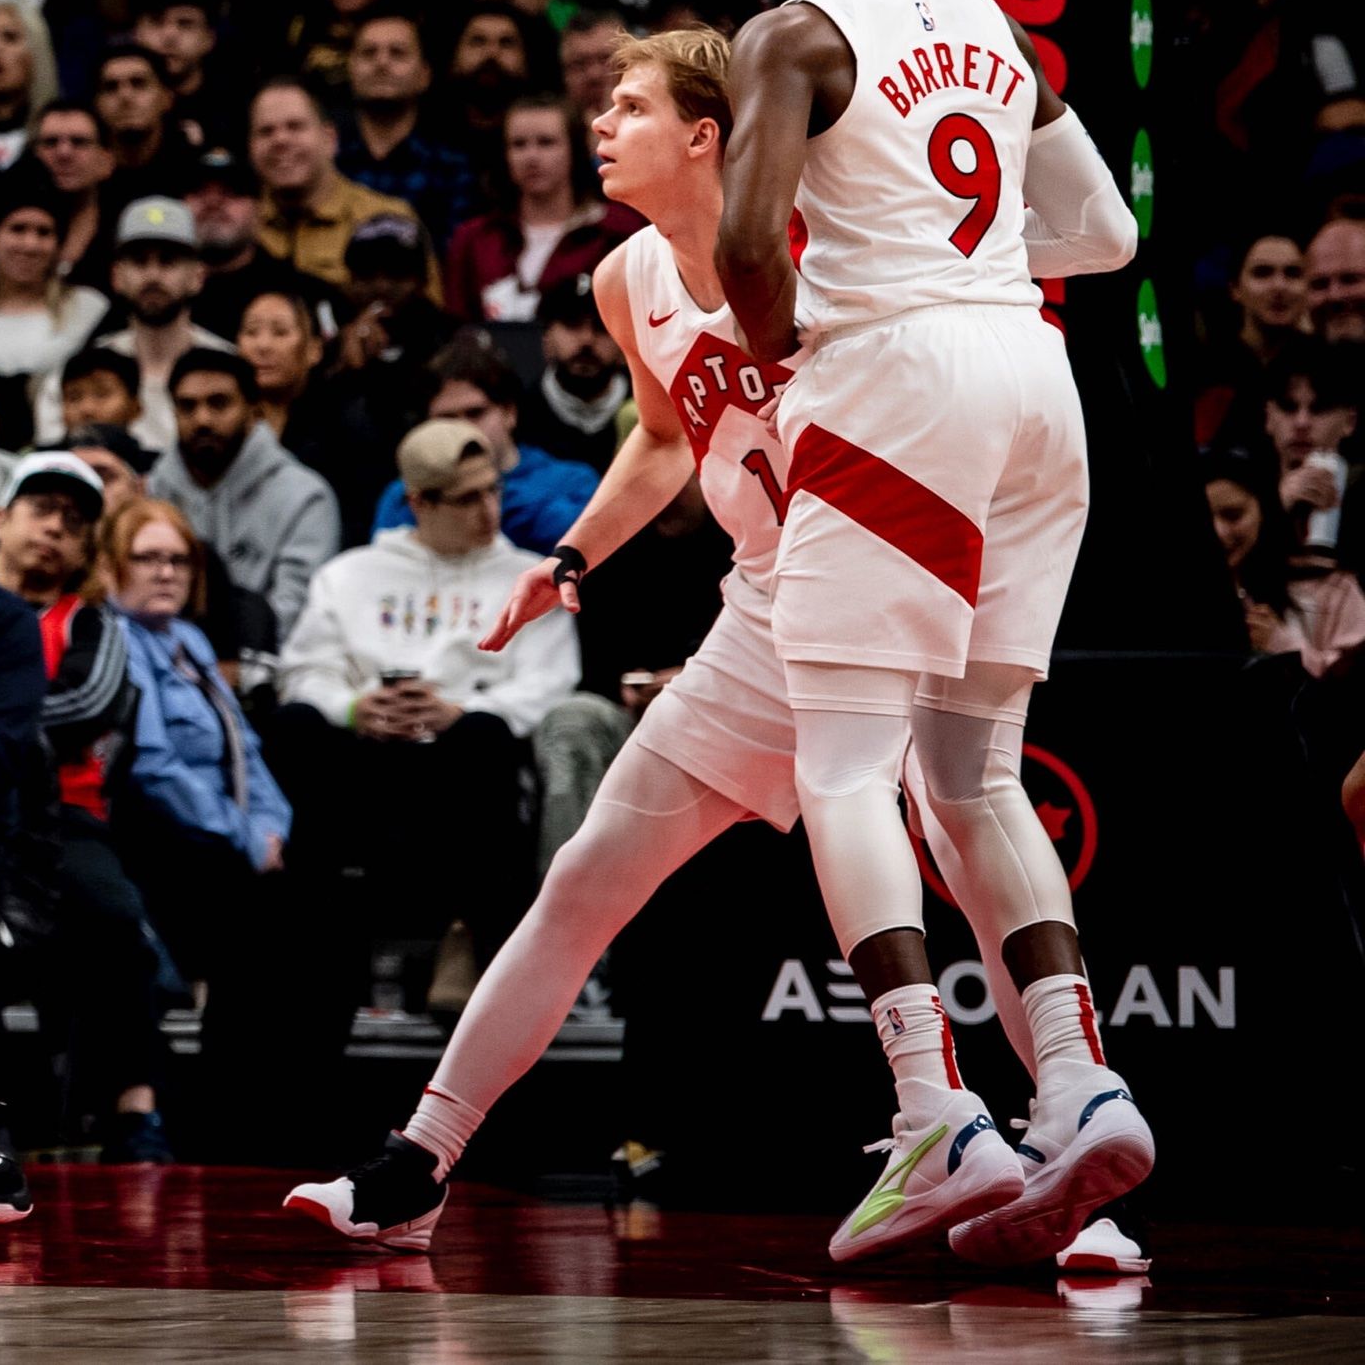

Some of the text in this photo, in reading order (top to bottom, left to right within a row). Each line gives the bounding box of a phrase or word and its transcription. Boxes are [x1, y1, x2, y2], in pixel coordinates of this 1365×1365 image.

[877, 42, 1026, 119] BARRETT
[927, 112, 1002, 259] 9
[762, 959, 1236, 1028] AEOAN
